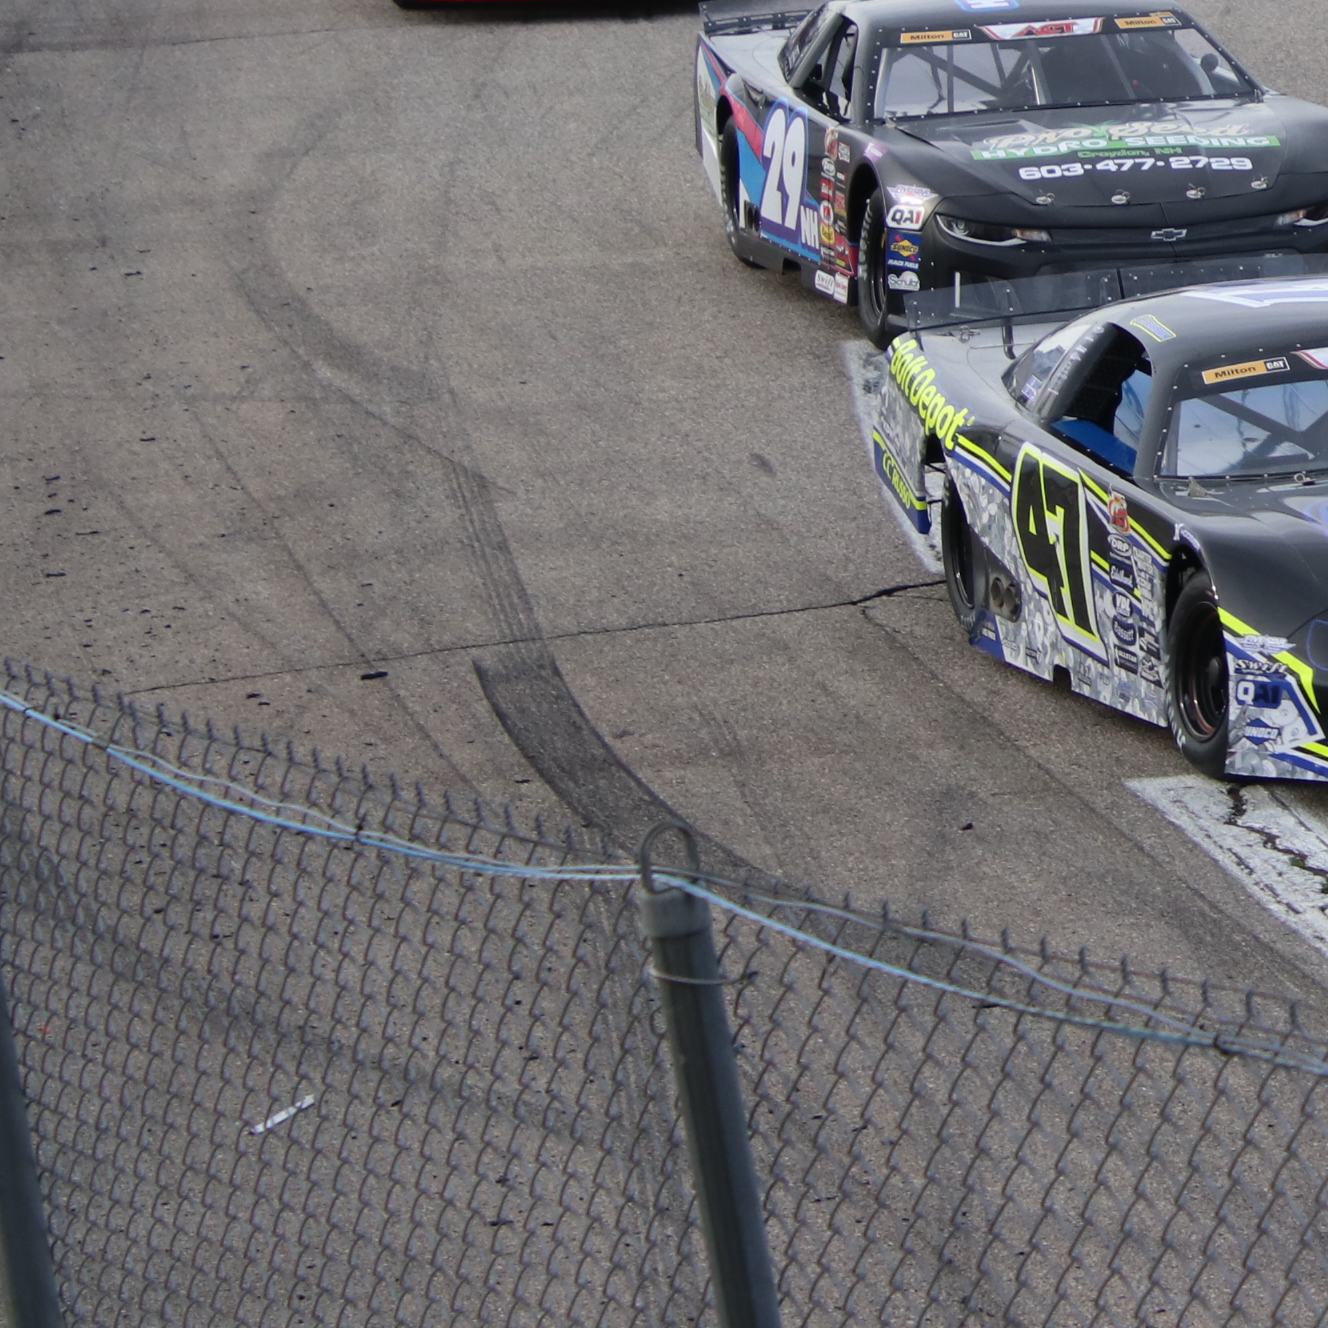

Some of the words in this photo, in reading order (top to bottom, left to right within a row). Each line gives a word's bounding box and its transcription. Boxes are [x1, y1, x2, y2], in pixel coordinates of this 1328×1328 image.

[1010, 22, 1078, 38] ACT
[981, 139, 1107, 159] HYDRO
[1126, 135, 1271, 147] SEEDING
[1155, 146, 1182, 155] NH
[761, 108, 806, 230] 29
[801, 205, 819, 249] NH
[892, 209, 922, 225] QA1
[1214, 365, 1257, 379] Milton
[1012, 444, 1104, 650] 47
[1237, 680, 1281, 706] QA1
